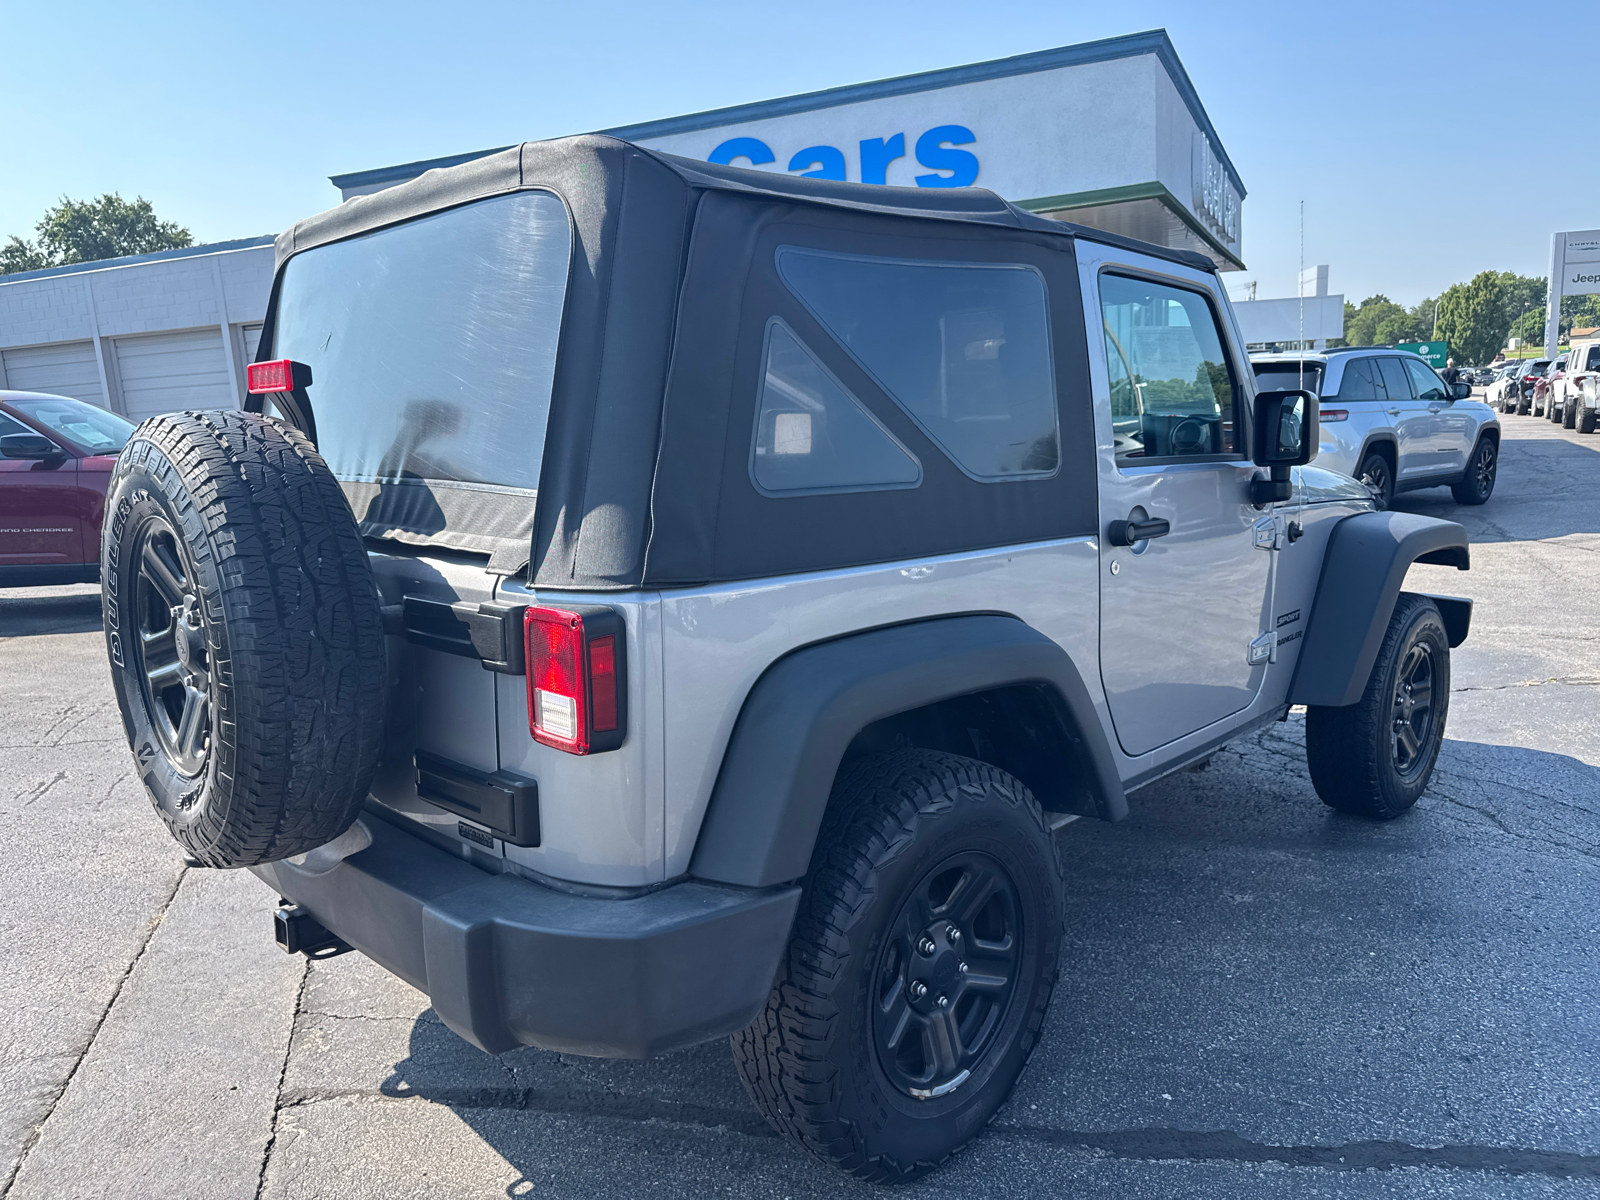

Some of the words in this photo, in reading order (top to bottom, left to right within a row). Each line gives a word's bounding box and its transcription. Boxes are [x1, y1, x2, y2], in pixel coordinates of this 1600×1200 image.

[1572, 273, 1600, 284] Jeep
[107, 495, 131, 668] DUELER
[131, 490, 150, 506] A/T
[1277, 610, 1301, 626] SPORT
[1277, 630, 1303, 647] RANGLER
